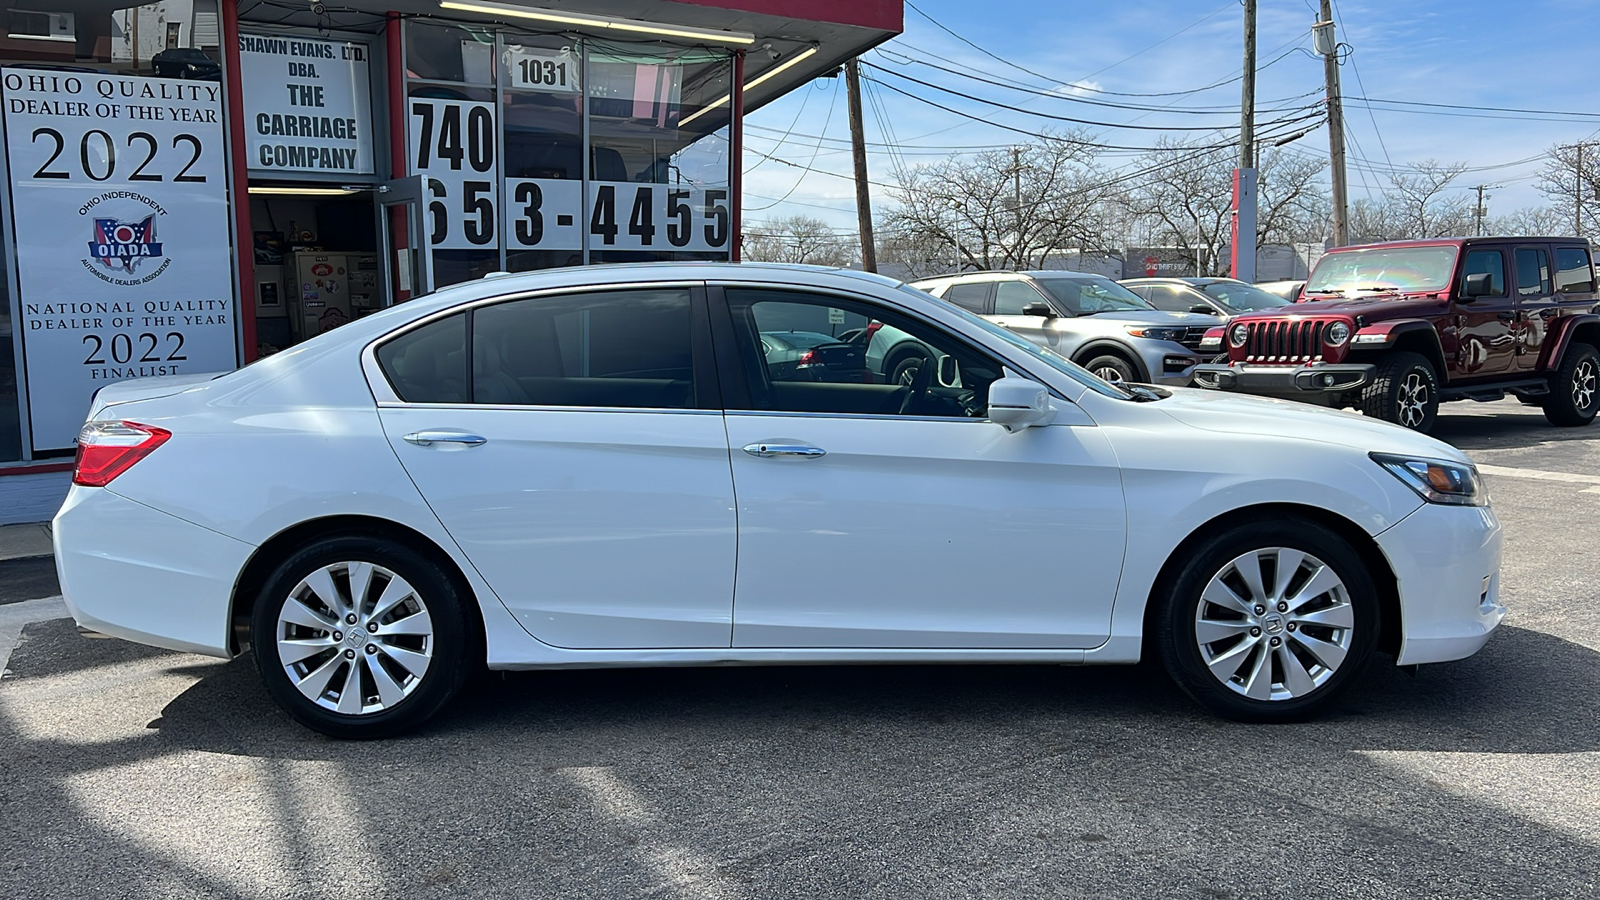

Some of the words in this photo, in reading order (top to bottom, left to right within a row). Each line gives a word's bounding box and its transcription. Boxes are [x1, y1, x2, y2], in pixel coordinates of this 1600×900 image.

[239, 37, 288, 55] SHAWN
[290, 41, 336, 60] EVANS.
[341, 46, 367, 62] LTD.
[288, 61, 320, 79] DBA.
[518, 58, 566, 87] 1031
[5, 73, 82, 95] OHIO
[97, 79, 219, 101] QUALITY
[286, 83, 325, 108] THE
[10, 98, 90, 117] DEALER
[95, 103, 120, 119] OF
[125, 105, 164, 121] THE
[168, 107, 218, 124] YEAR
[256, 112, 357, 140] CARRIAGE
[412, 102, 494, 173] 740
[31, 127, 207, 183] 2022
[259, 144, 357, 170] COMPANY
[79, 197, 101, 216] OHIO
[101, 191, 168, 216] INDEPENDENT
[98, 244, 151, 256] OIADA
[81, 259, 114, 284] AUTOMOBILE
[114, 277, 142, 286] DEALERS
[142, 257, 172, 284] ASSOCIATION
[26, 302, 135, 315] NATIONAL
[144, 299, 229, 314] QUALITY
[30, 318, 104, 330] DEALER
[112, 317, 134, 328] OF
[142, 316, 176, 327] THE
[183, 314, 226, 326] YEAR
[82, 331, 188, 365] 2022
[91, 365, 179, 379] FINALIST
